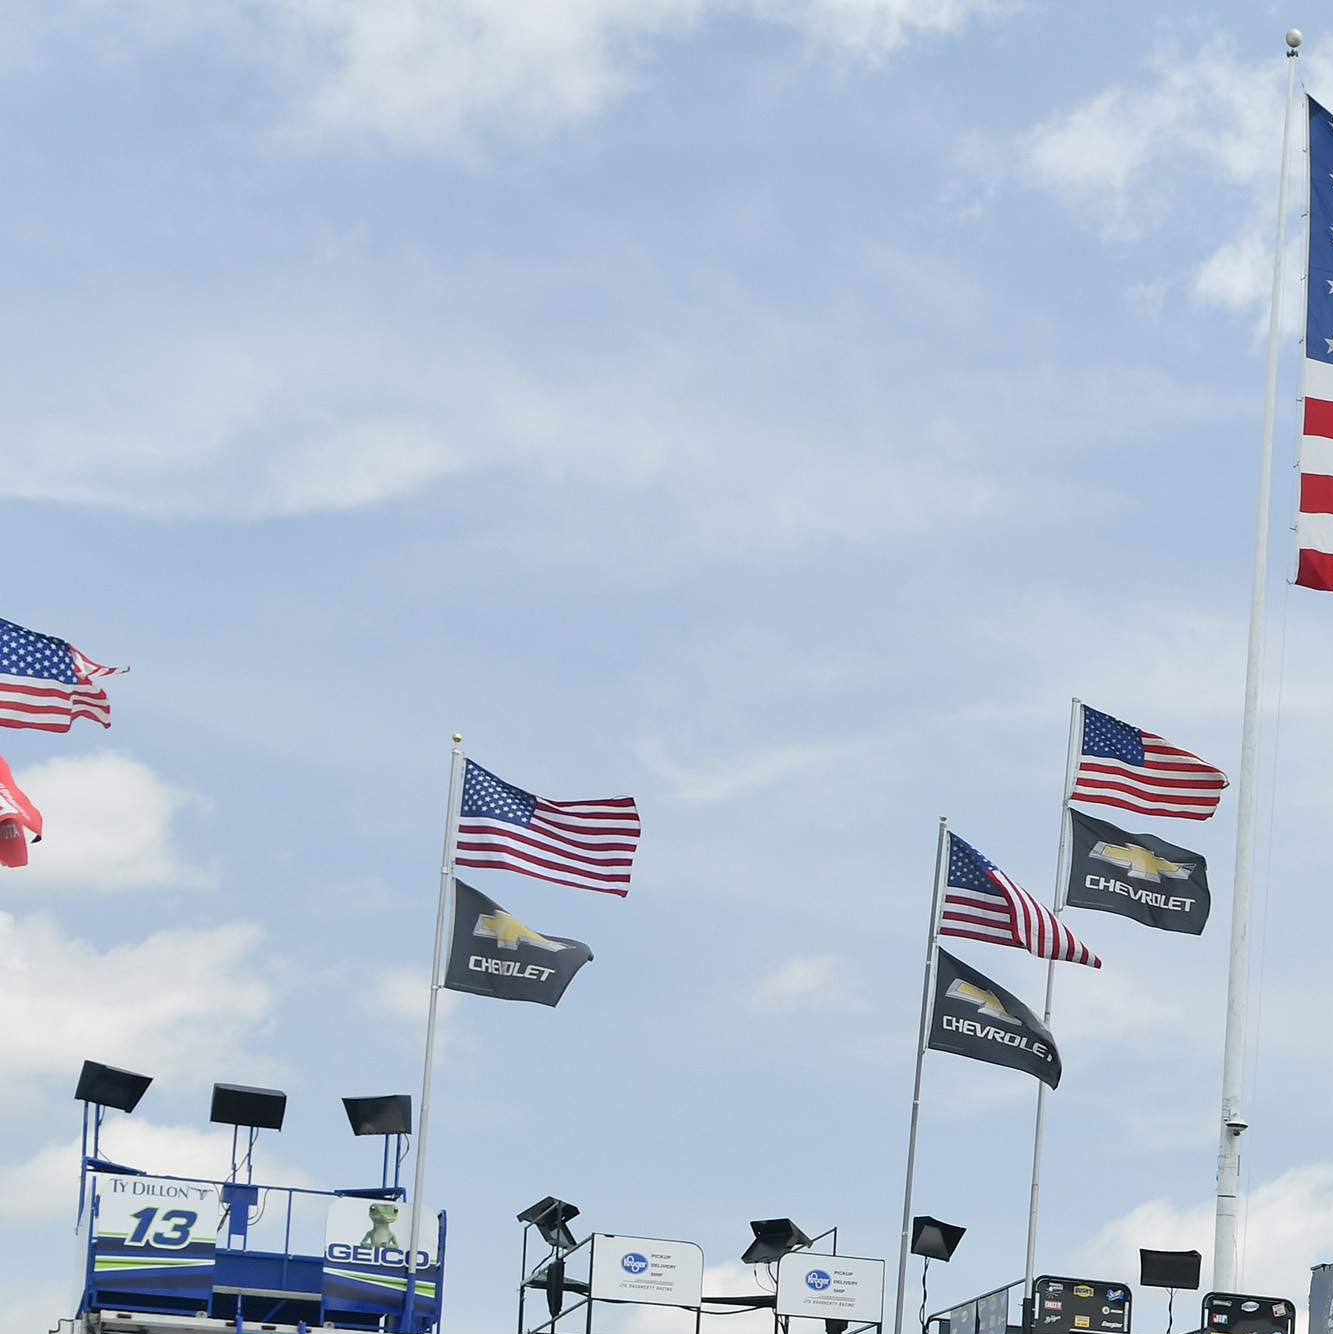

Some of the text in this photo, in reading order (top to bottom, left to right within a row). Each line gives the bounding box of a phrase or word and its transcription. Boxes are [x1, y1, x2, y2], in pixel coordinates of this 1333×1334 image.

[1085, 874, 1196, 913] CHEVROLET
[132, 1180, 190, 1200] DILLON
[124, 1205, 198, 1249] 13
[327, 1243, 430, 1269] GEICO
[623, 1255, 648, 1273] Kroger
[807, 1271, 831, 1289] Kroger
